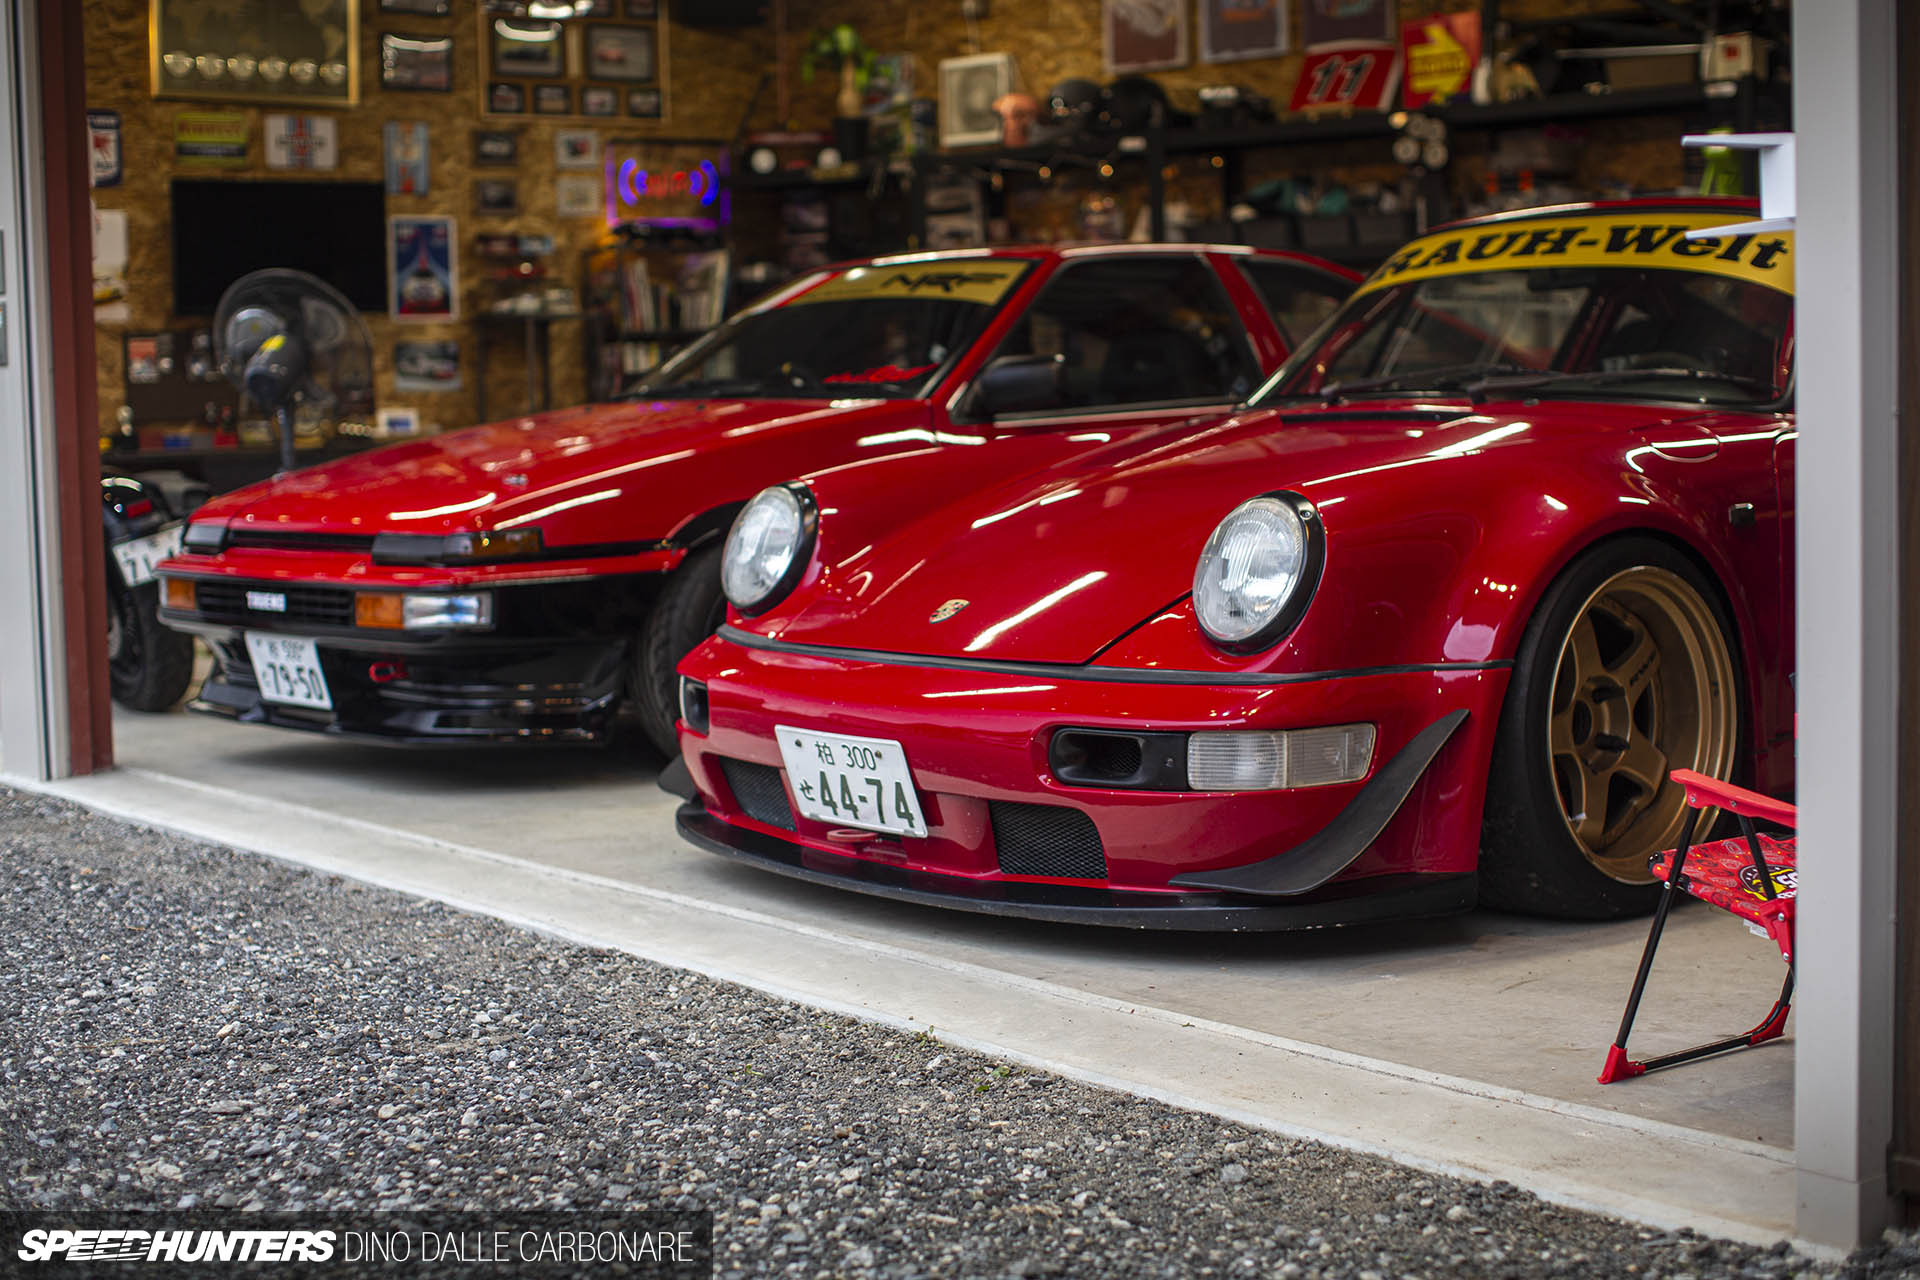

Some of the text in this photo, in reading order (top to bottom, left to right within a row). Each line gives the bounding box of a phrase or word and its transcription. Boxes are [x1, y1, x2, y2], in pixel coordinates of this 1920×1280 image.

[1308, 53, 1376, 104] 11
[266, 662, 325, 701] 79-50
[814, 740, 877, 771] 柏 300
[800, 770, 916, 829] せ 44-74
